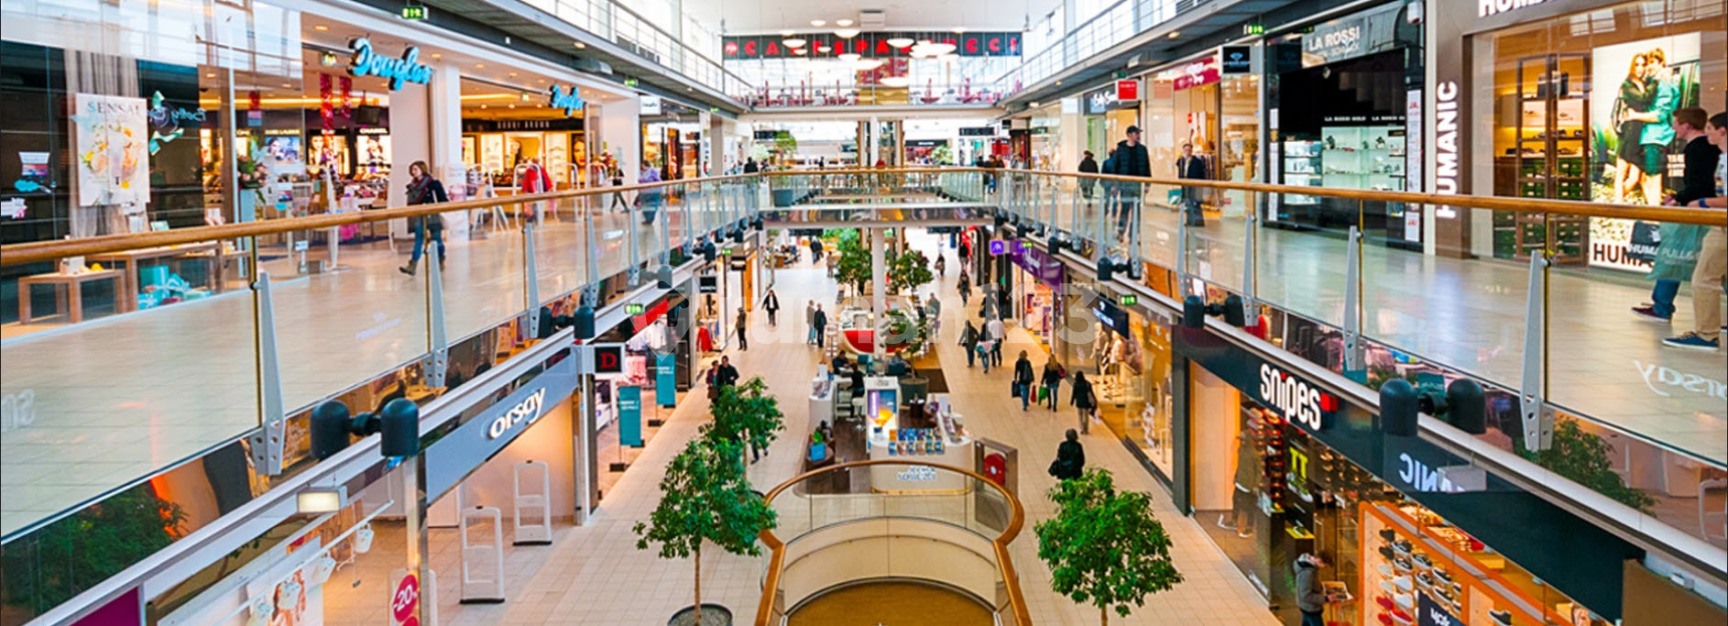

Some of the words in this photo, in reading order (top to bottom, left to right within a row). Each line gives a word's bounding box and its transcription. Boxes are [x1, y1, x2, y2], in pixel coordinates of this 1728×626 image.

[348, 37, 433, 91] Douglas
[1308, 37, 1323, 52] LA
[1324, 25, 1361, 48] ROSSI
[601, 352, 617, 369] D
[489, 386, 546, 438] orsay
[1260, 363, 1321, 431] snipes
